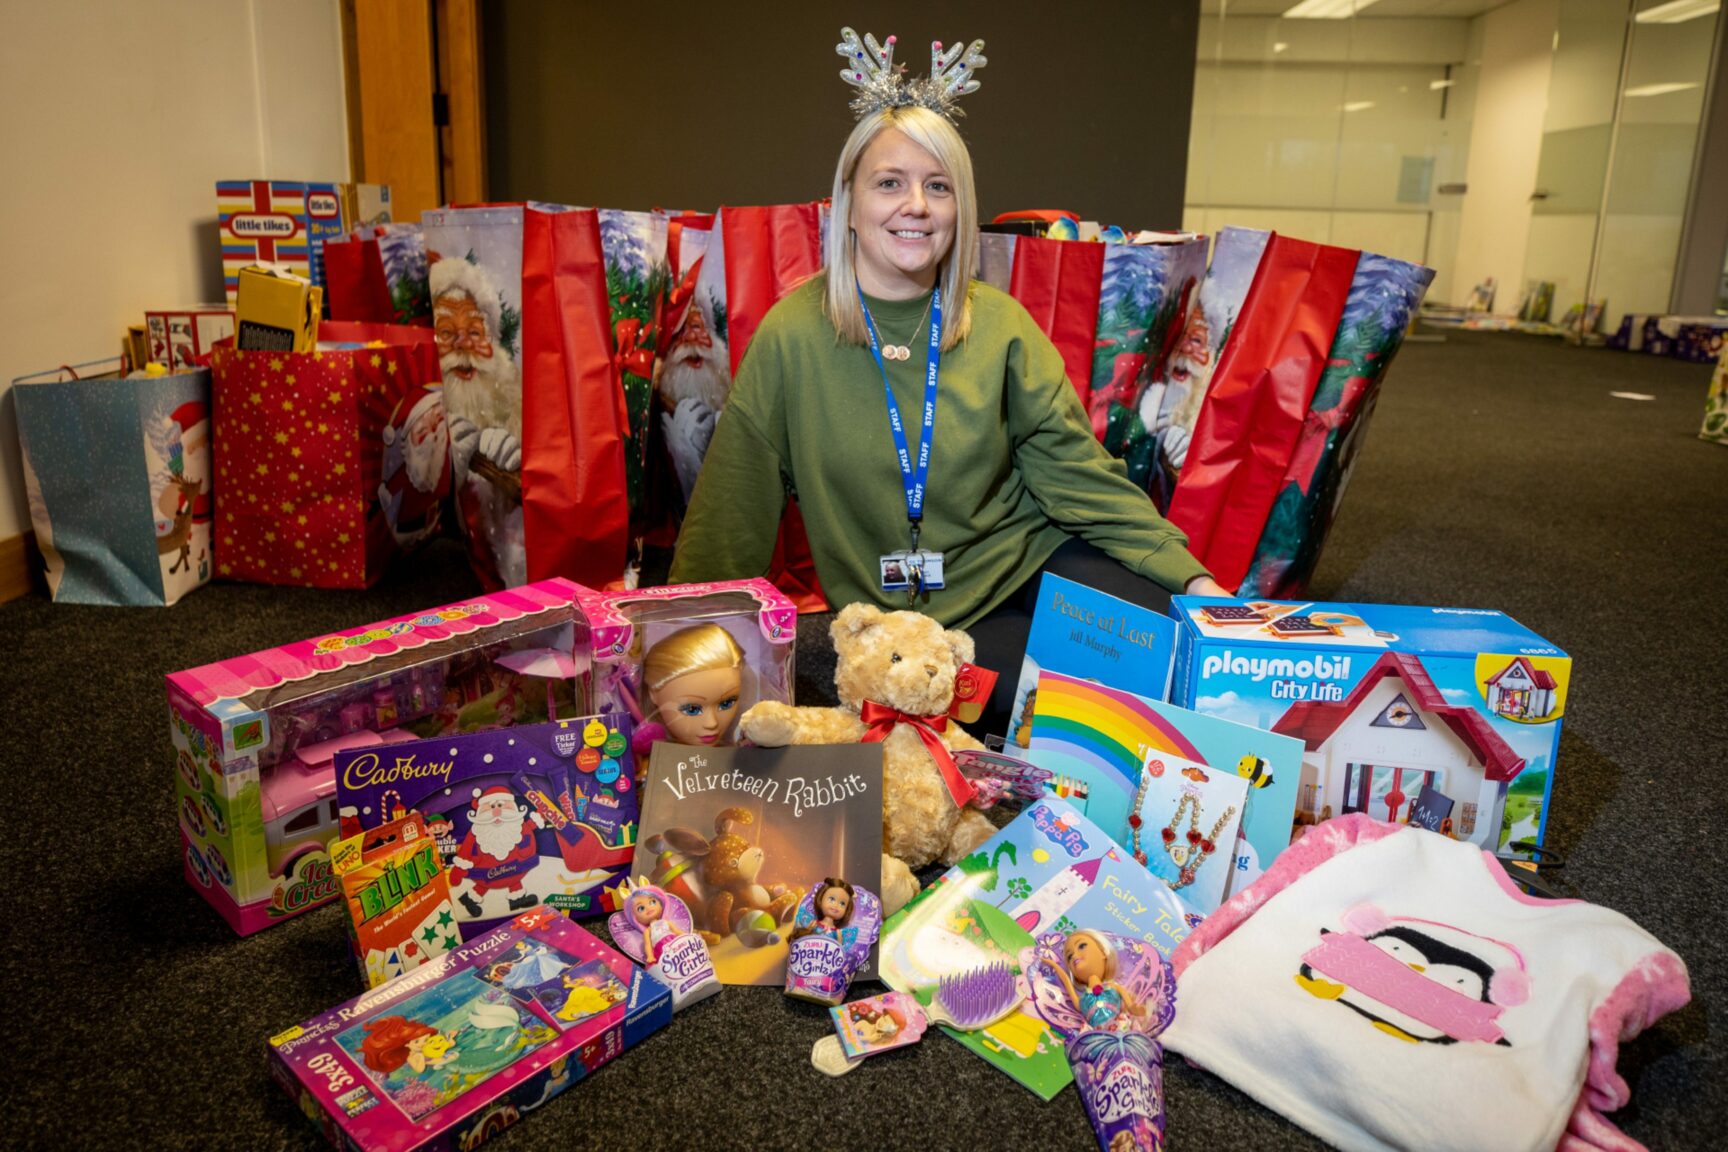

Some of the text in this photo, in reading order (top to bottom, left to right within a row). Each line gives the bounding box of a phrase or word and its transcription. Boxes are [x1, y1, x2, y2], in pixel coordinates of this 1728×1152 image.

[235, 219, 290, 231] little tikes
[931, 323, 939, 347] STAFF
[928, 361, 937, 386] STAFF
[890, 407, 901, 432] STAFF
[924, 401, 934, 427] STAFF
[899, 448, 910, 474] STAFF
[919, 441, 929, 468] STAFF
[913, 483, 923, 509] STAFF
[1052, 591, 1156, 650] Peace at Last
[1085, 633, 1122, 662] Murphy
[1202, 650, 1351, 682] playmobil
[1271, 679, 1343, 701] City Life
[555, 732, 577, 743] FREE
[343, 753, 454, 790] Cadbury
[689, 754, 708, 769] The
[559, 791, 576, 821] Wisp
[783, 773, 868, 817] Rabbit
[1035, 805, 1083, 858] Peppa Pig
[303, 862, 334, 884] Ice
[338, 850, 360, 872] UNO
[487, 864, 517, 880] Cadbury
[287, 878, 338, 909] Crea
[1103, 875, 1148, 914] Fairy
[520, 914, 540, 928] 5+
[1105, 901, 1172, 956] Sticker Book
[662, 938, 704, 973] Sparkle
[679, 951, 708, 977] Girlz
[790, 942, 844, 967] Sparkle
[337, 930, 511, 1021] Ravensburger Puzzle
[802, 961, 829, 976] Girlz
[626, 996, 670, 1026] Ravensburger
[307, 1053, 354, 1092] 3x49
